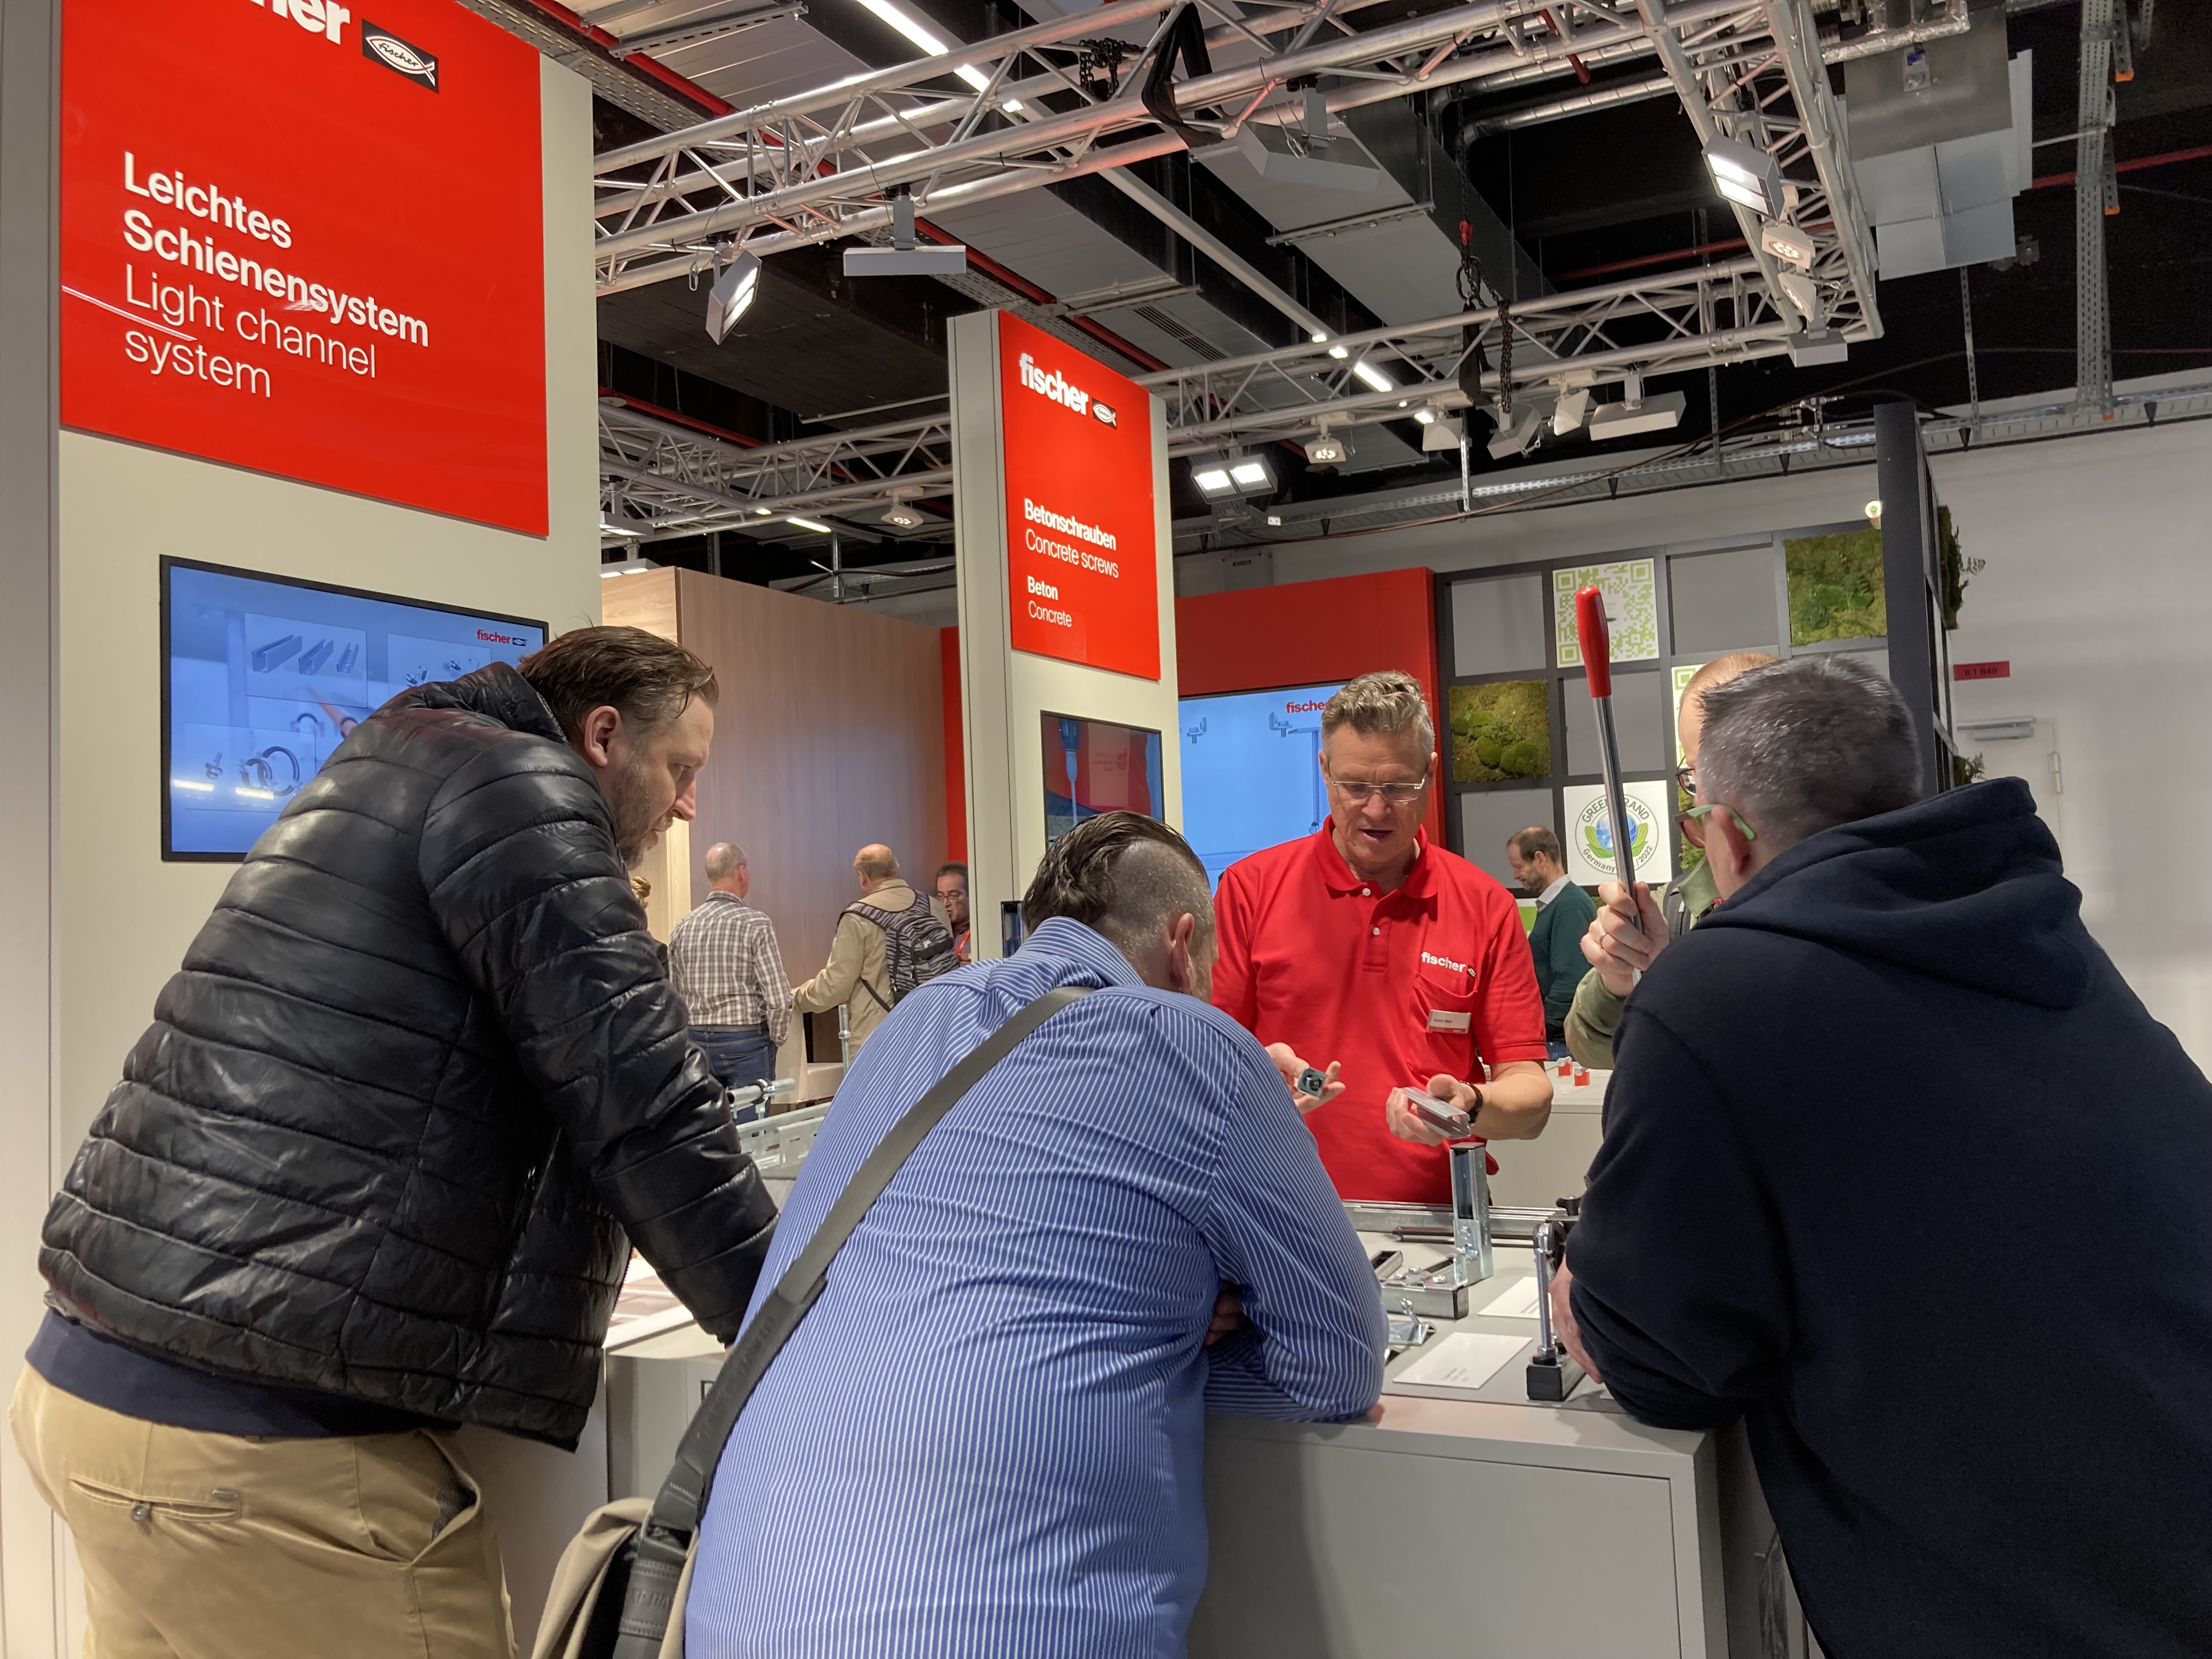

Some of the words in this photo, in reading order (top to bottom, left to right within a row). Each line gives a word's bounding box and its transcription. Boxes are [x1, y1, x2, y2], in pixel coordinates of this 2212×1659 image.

[379, 42, 419, 67] fischer
[124, 151, 292, 249] Leichtes
[123, 210, 429, 348] Schienensystem
[126, 264, 224, 331] Light
[236, 308, 376, 379] channel
[125, 331, 271, 398] system
[1019, 353, 1089, 415] fischer
[1024, 498, 1116, 551] Betonschrauben
[1026, 528, 1079, 565] Concrete
[1081, 552, 1119, 578] screws
[1027, 575, 1058, 601] Beton
[1028, 600, 1072, 627] Concrete
[476, 629, 511, 644] fischer
[1624, 798, 1650, 820] RAND
[1583, 848, 1616, 873] Germany
[1421, 951, 1466, 972] fischer
